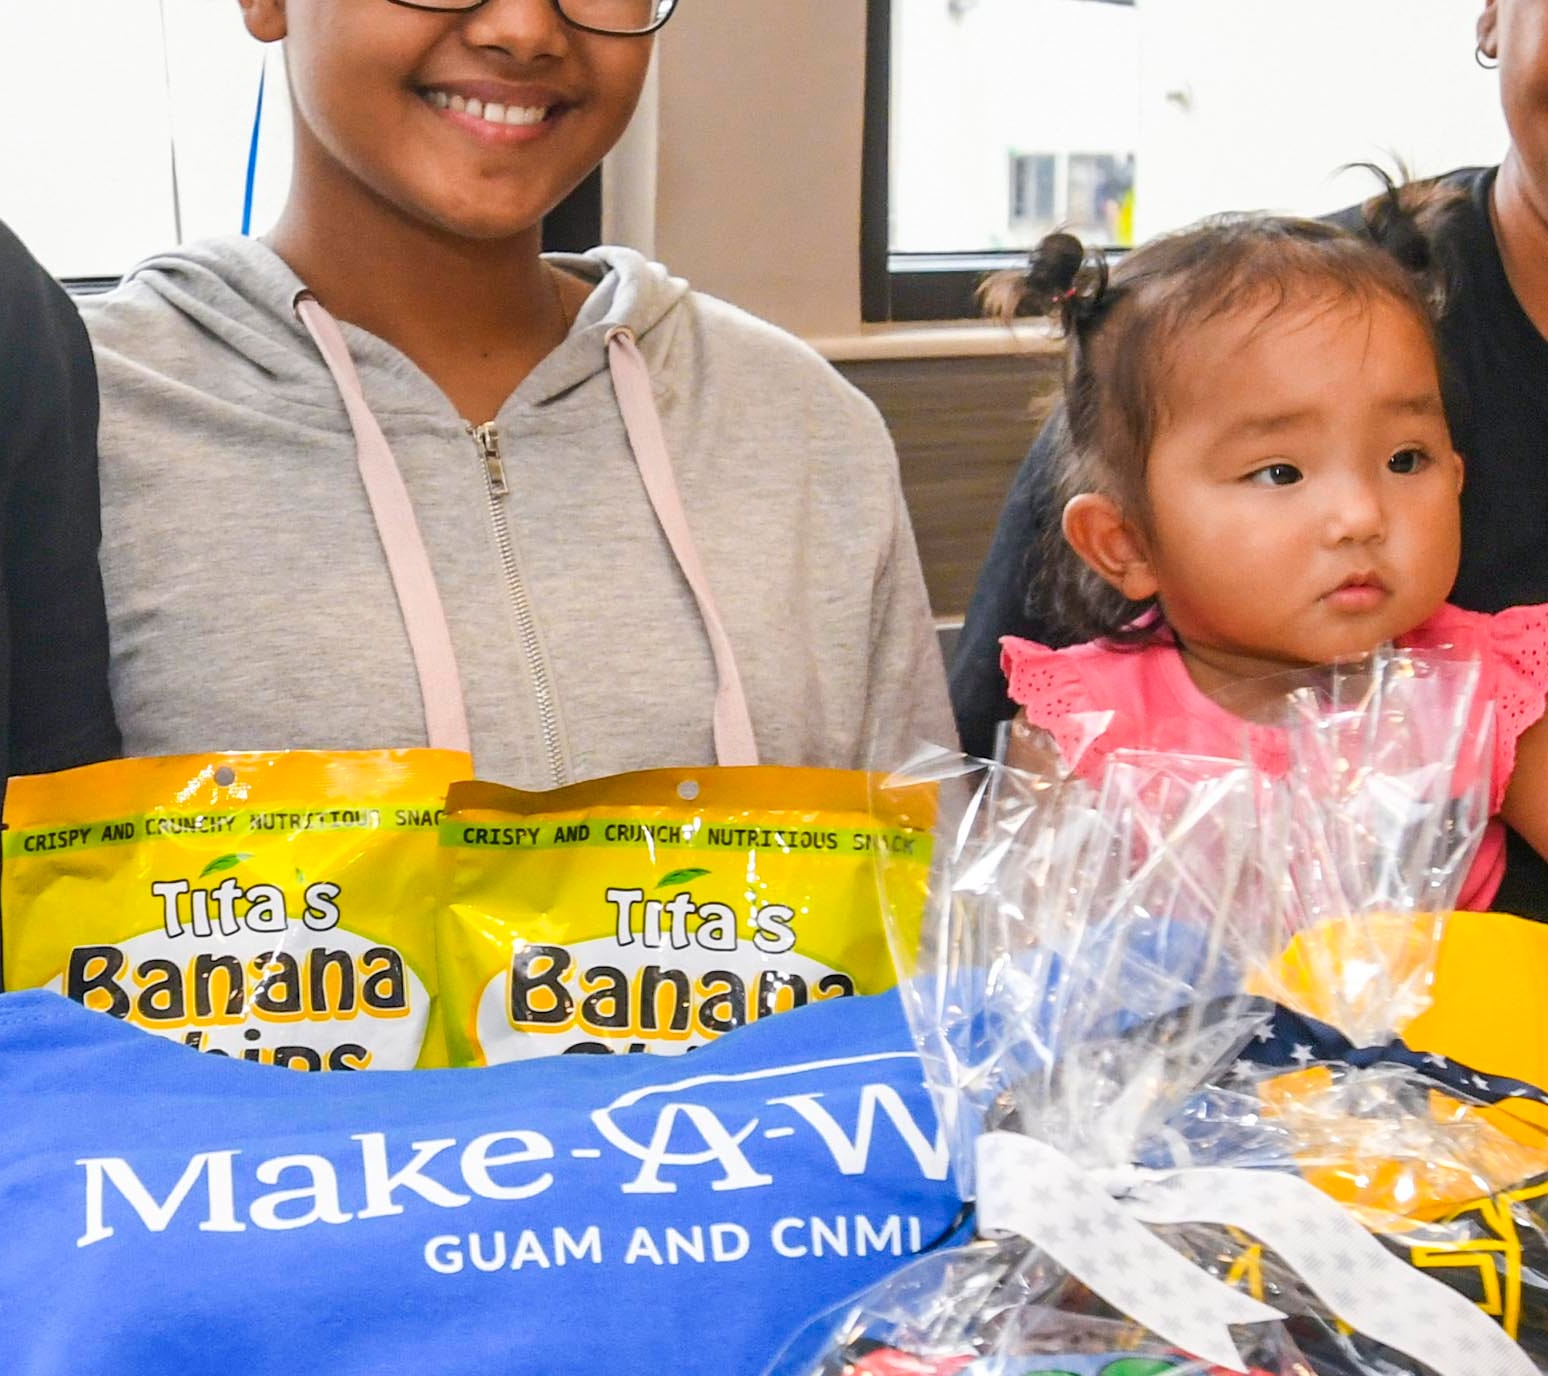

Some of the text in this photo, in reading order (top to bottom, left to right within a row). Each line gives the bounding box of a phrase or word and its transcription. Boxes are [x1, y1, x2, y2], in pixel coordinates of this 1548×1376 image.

[23, 826, 93, 853] CRISPY
[102, 822, 136, 843] AND
[145, 814, 235, 837] CRUNCHY
[250, 808, 381, 832] NUTRITIOUS
[463, 826, 540, 846] CRISPY
[554, 824, 591, 843] AND
[708, 827, 838, 851] NUTRITIOUS
[67, 943, 408, 1024] Banana
[423, 1214, 922, 1276] GUAM AND CNMI
